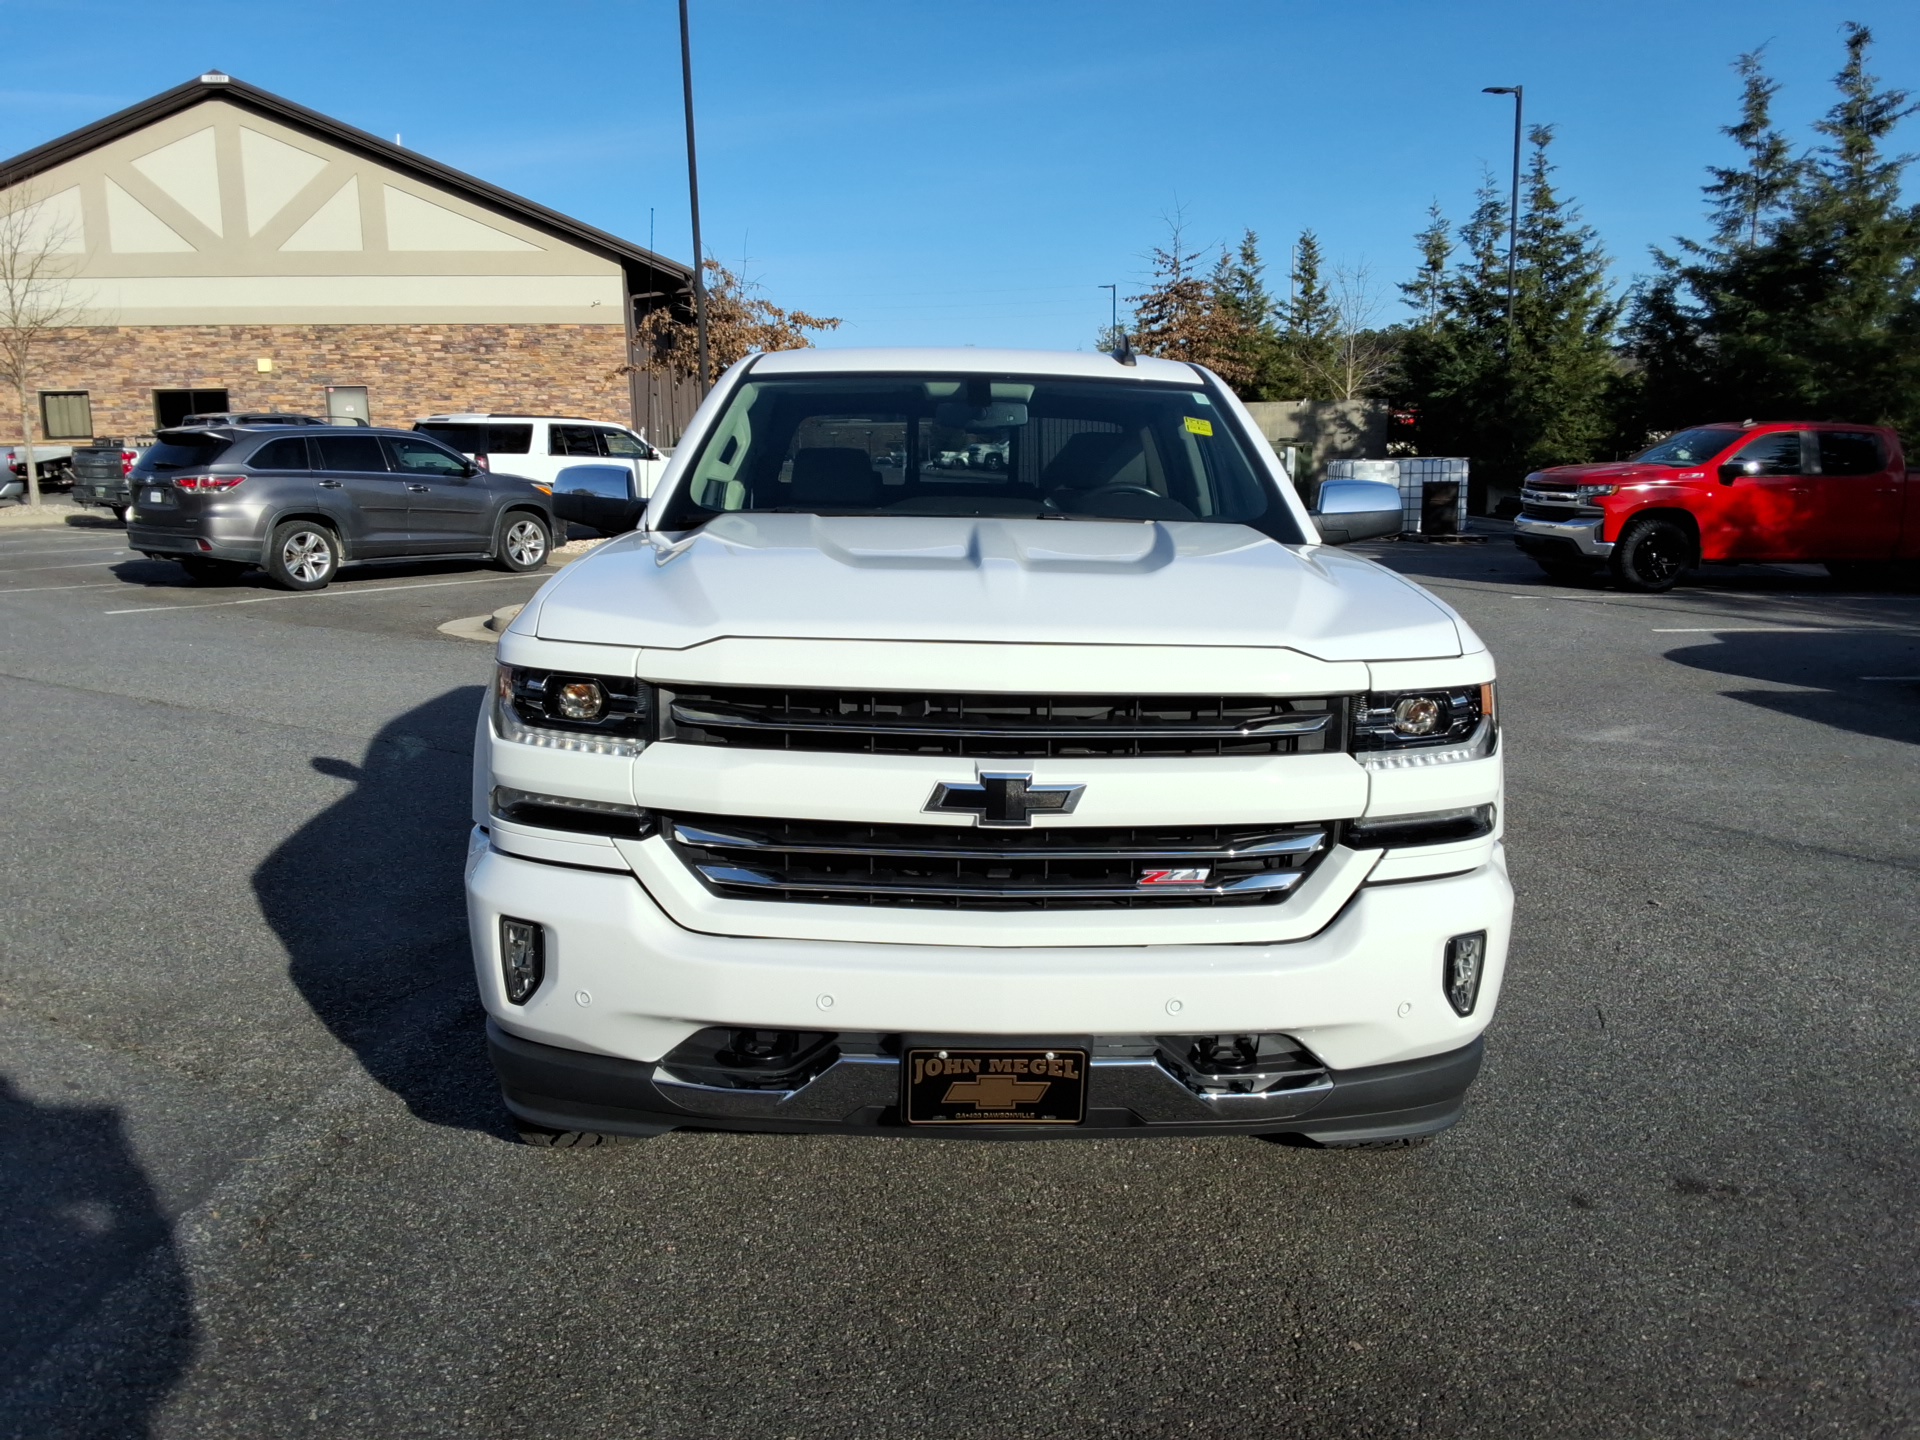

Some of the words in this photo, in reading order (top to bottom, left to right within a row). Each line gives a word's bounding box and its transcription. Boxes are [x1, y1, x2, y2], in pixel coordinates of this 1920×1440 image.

[1138, 868, 1211, 885] Z71
[914, 1058, 982, 1085] JOHN
[988, 1058, 1079, 1080] MEGEL
